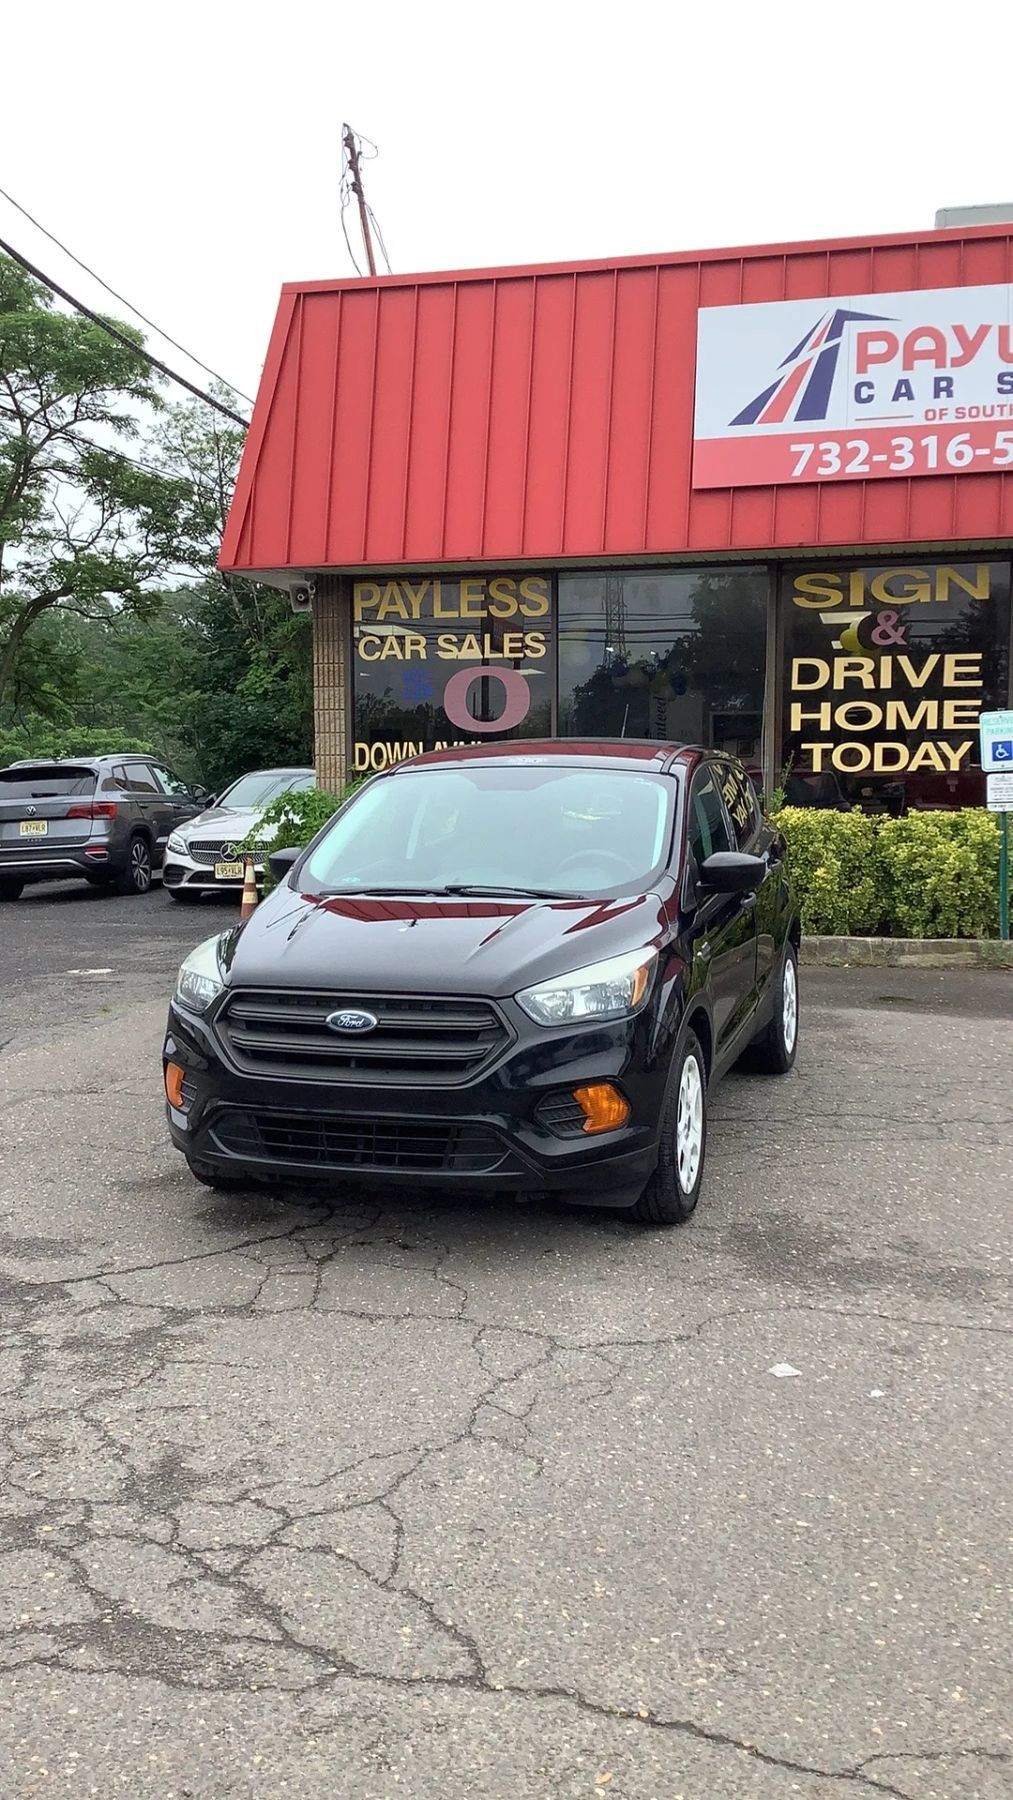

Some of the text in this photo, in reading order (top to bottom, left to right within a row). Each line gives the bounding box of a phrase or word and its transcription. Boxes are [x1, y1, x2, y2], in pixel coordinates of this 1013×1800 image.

[854, 376, 954, 404] CAR
[924, 408, 949, 421] OF
[353, 577, 550, 621] PAYLESS
[792, 566, 991, 609] SIGN
[871, 610, 907, 645] &
[358, 632, 547, 661] CAR SALES
[791, 653, 984, 691] DRIVE
[790, 700, 982, 731] HOME
[801, 741, 974, 773] TODAY
[337, 1014, 365, 1027] Ford
